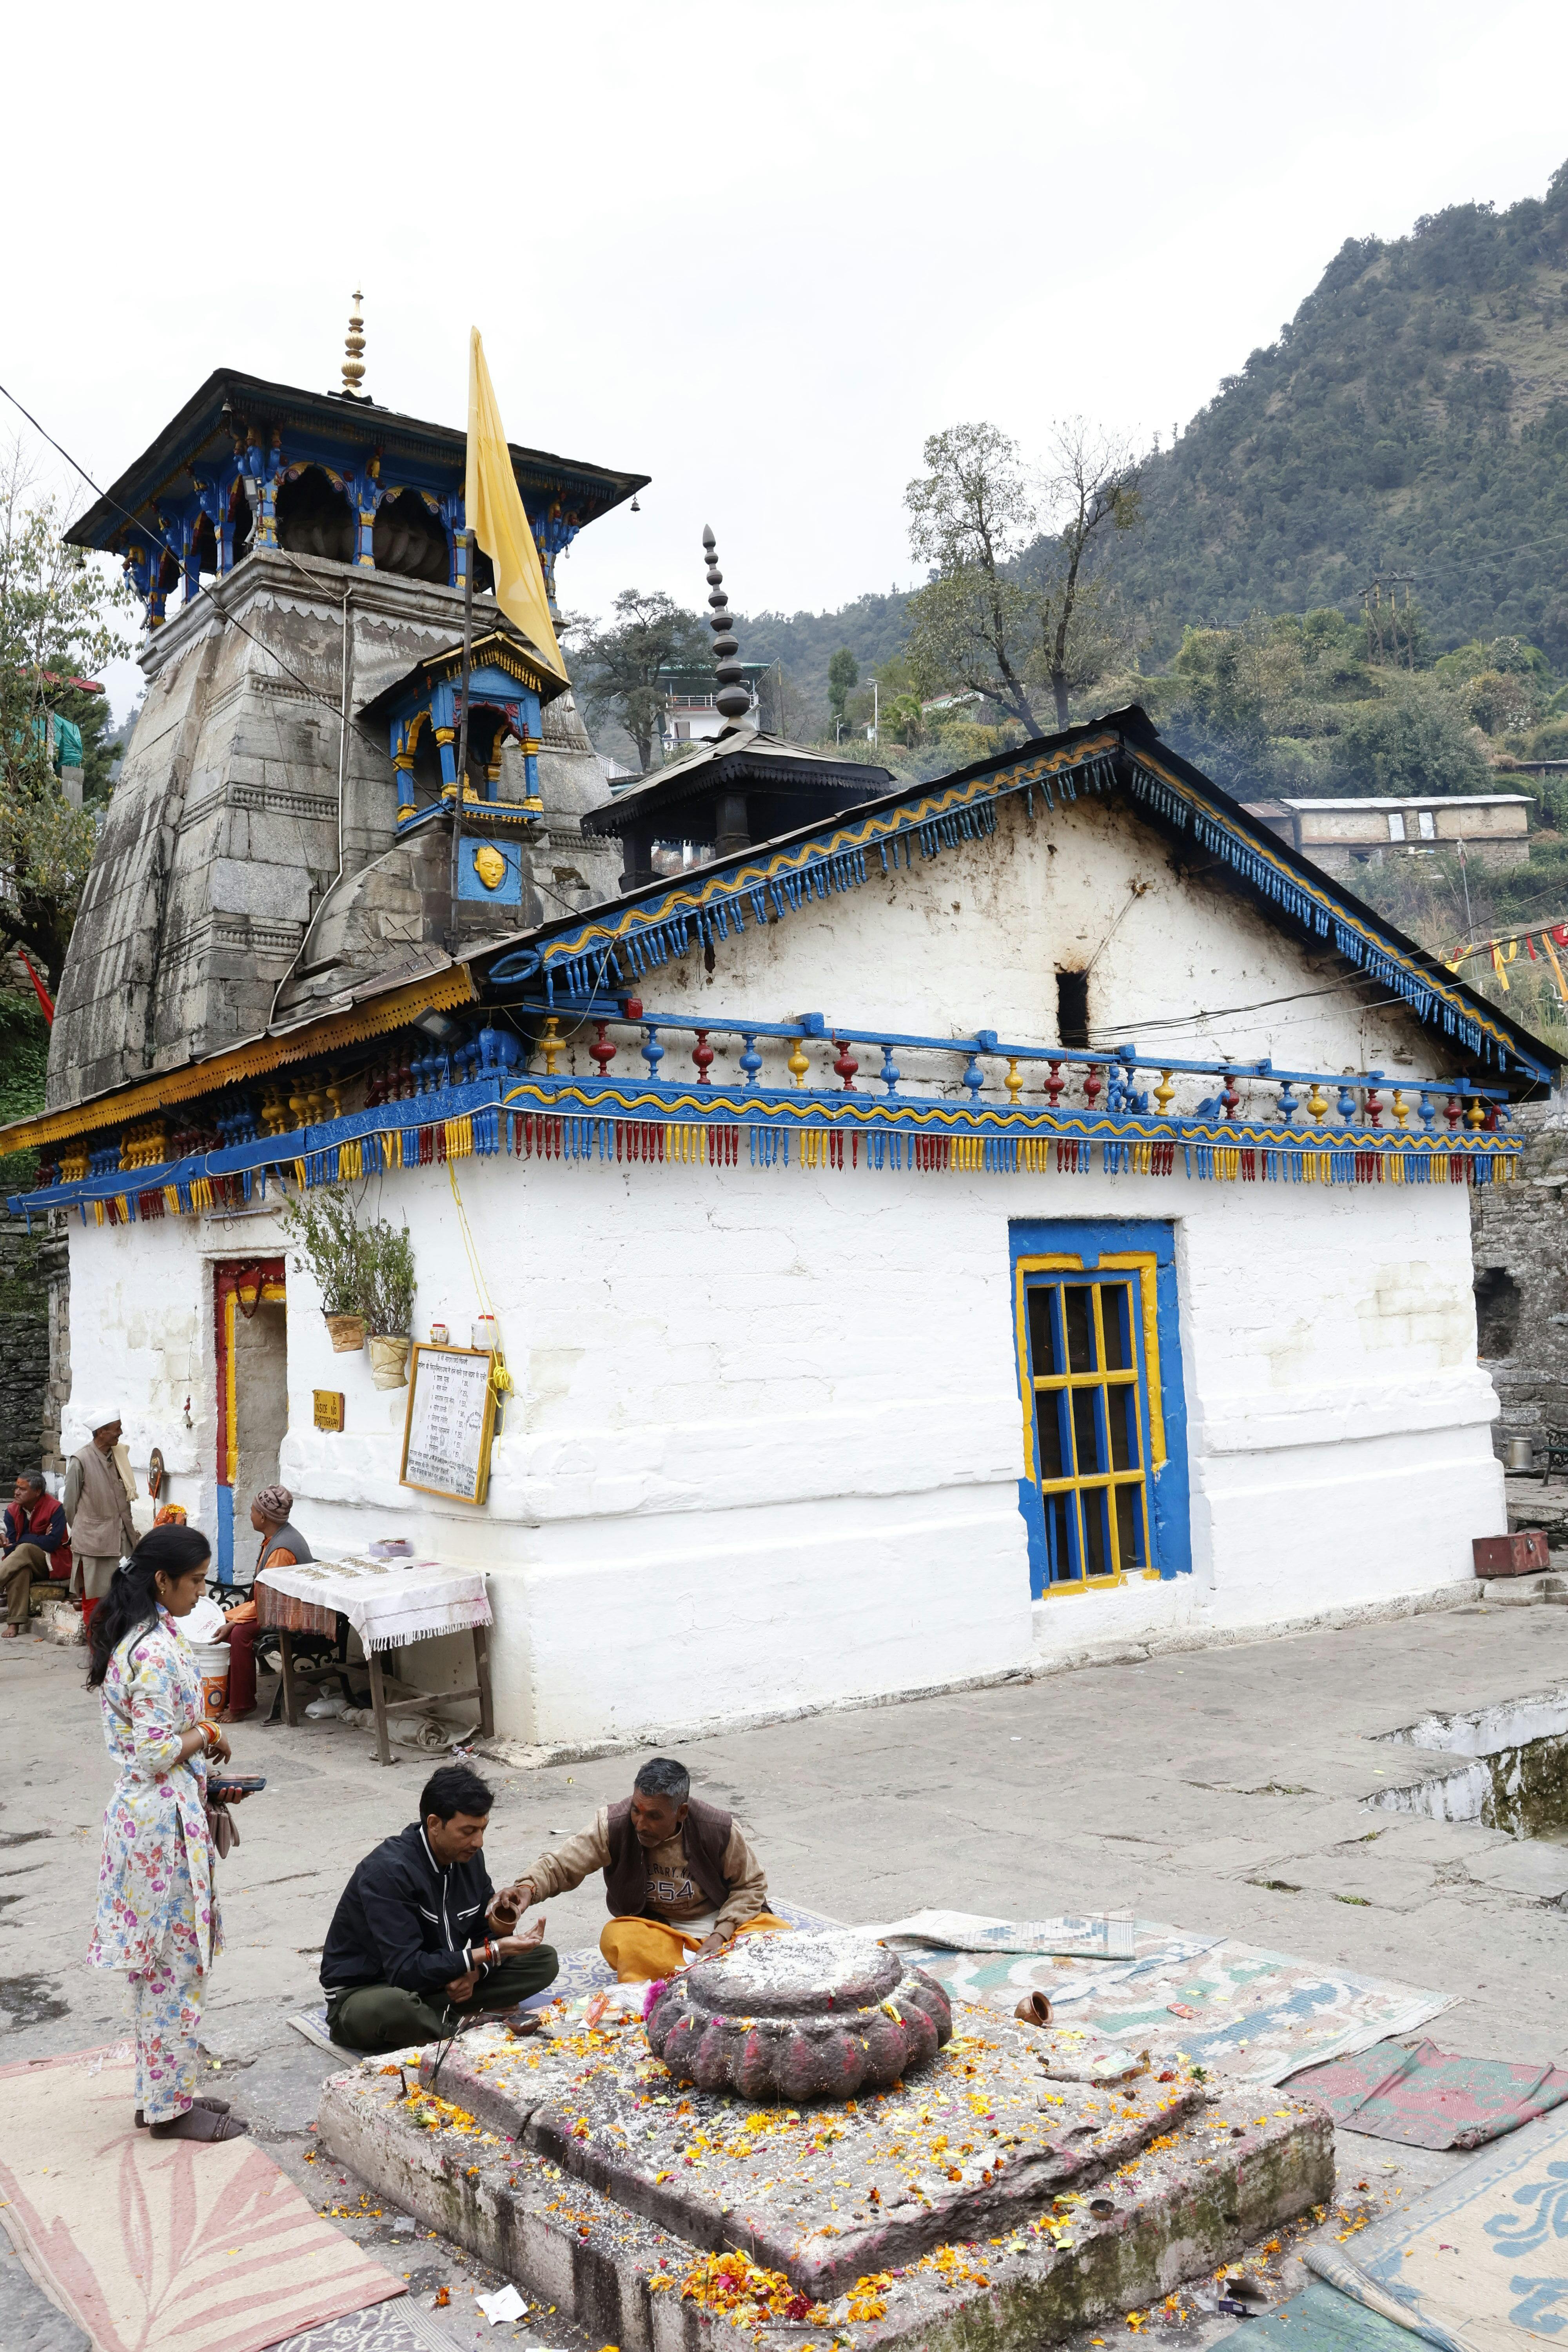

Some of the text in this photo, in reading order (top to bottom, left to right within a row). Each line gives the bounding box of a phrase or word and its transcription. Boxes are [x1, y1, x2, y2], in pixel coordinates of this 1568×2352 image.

[315, 1403, 336, 1416] INSIDE NO
[315, 1414, 339, 1429] PHOTOGRAPHY
[647, 1880, 694, 1902] 254
